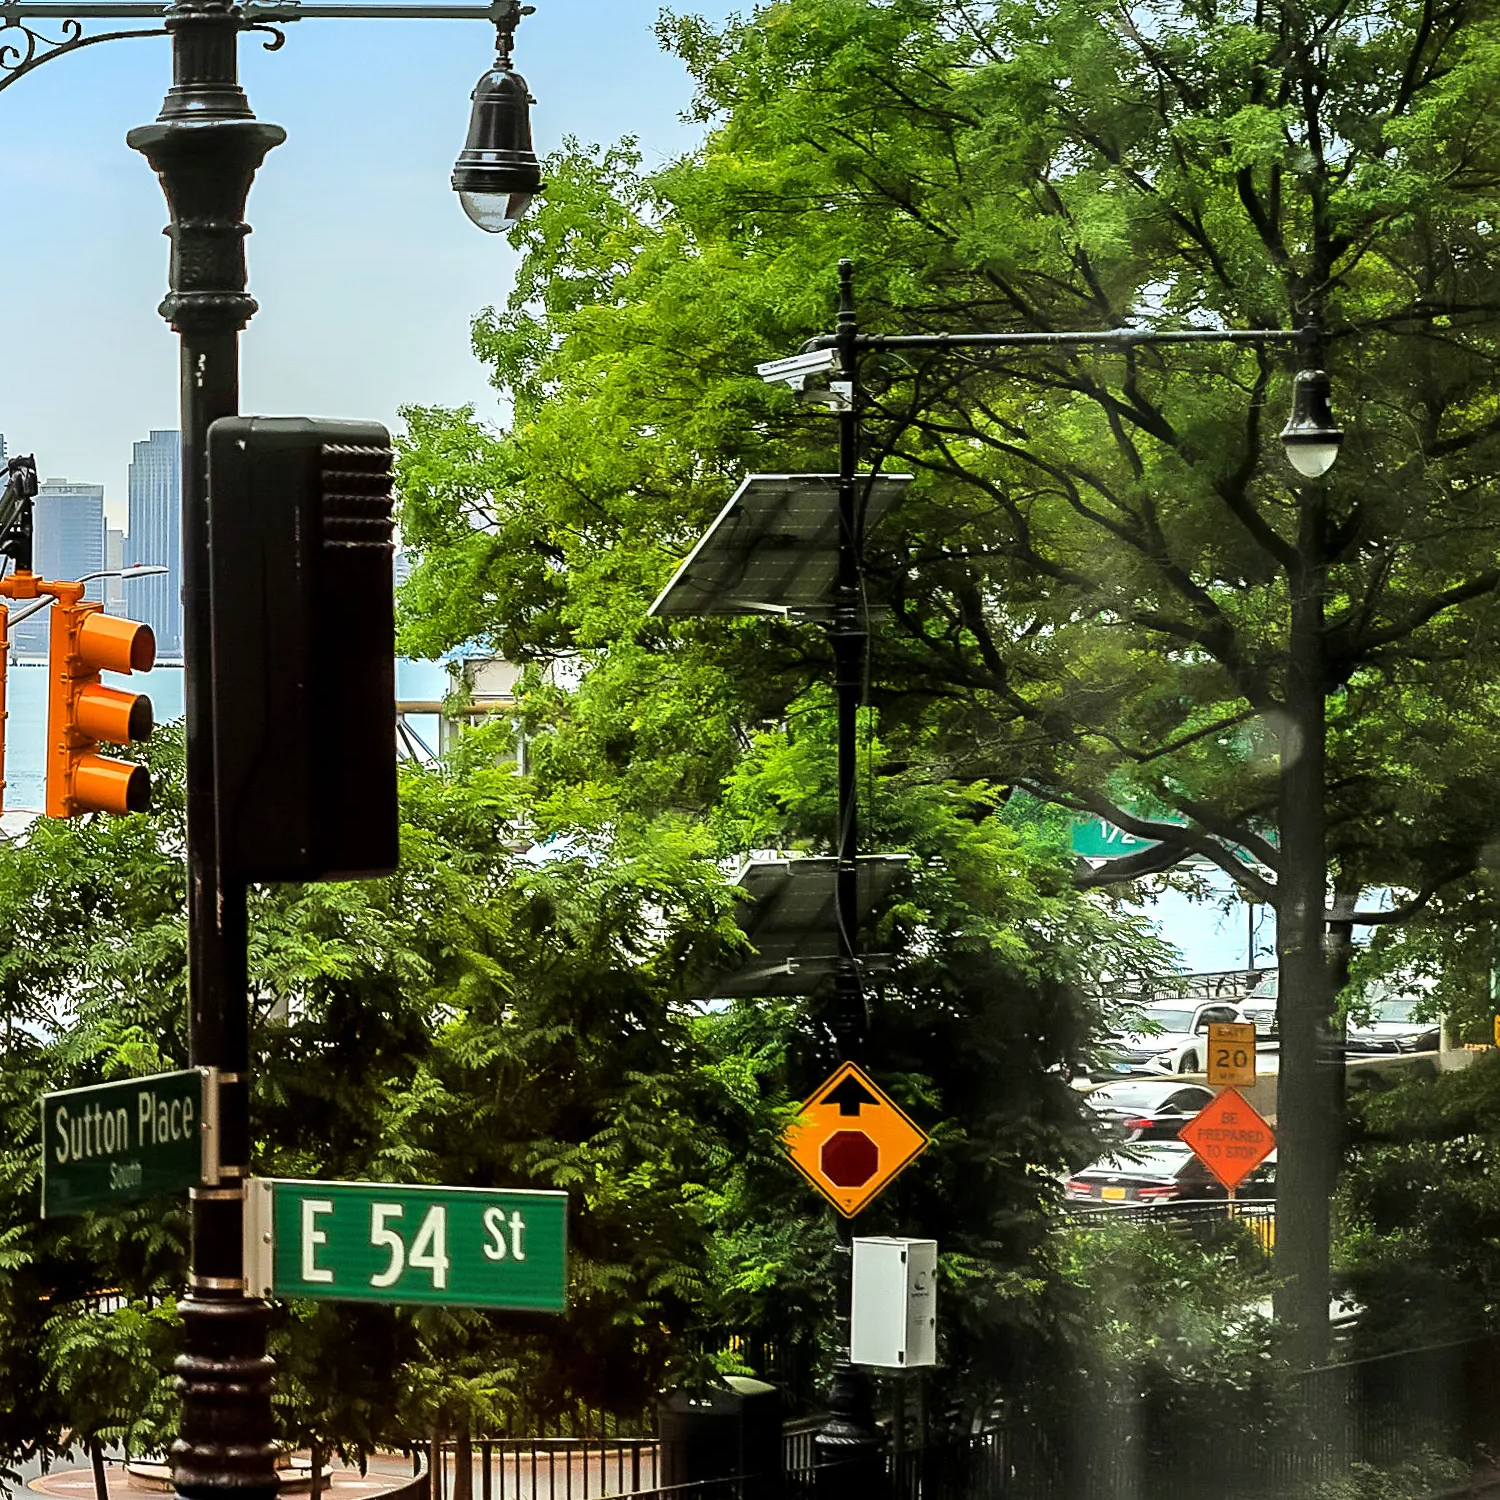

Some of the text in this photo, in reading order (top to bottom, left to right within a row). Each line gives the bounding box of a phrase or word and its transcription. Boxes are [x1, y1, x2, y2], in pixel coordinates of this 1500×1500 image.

[1216, 1049, 1248, 1068] 20
[1221, 1112, 1238, 1125] BE
[55, 1091, 194, 1164] Sutton Place
[1197, 1128, 1265, 1144] PREPARED
[1206, 1145, 1258, 1159] TO STOP
[301, 1198, 526, 1289] E 54 St
